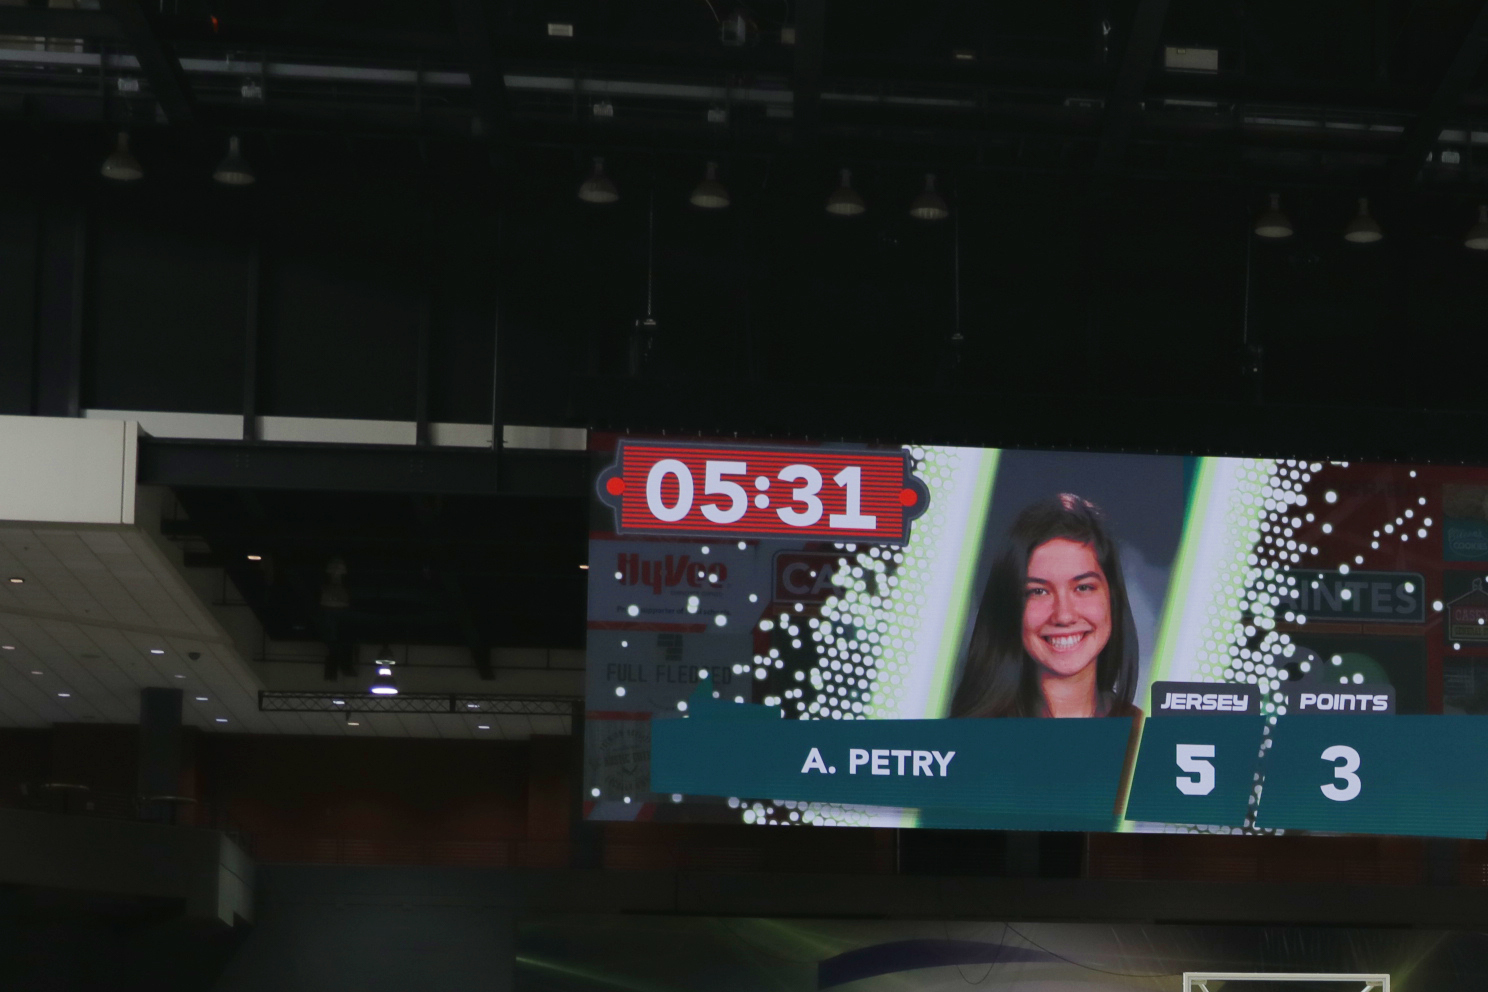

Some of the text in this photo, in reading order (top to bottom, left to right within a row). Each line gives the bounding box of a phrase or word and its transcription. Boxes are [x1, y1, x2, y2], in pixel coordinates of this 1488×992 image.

[645, 458, 877, 530] 05:31
[606, 663, 732, 686] FULL FLEDED
[1160, 693, 1248, 712] JERSEY
[1300, 693, 1388, 712] POINTS
[801, 748, 956, 777] A. PETRY
[1175, 744, 1216, 796] 5
[1320, 745, 1361, 801] 3
